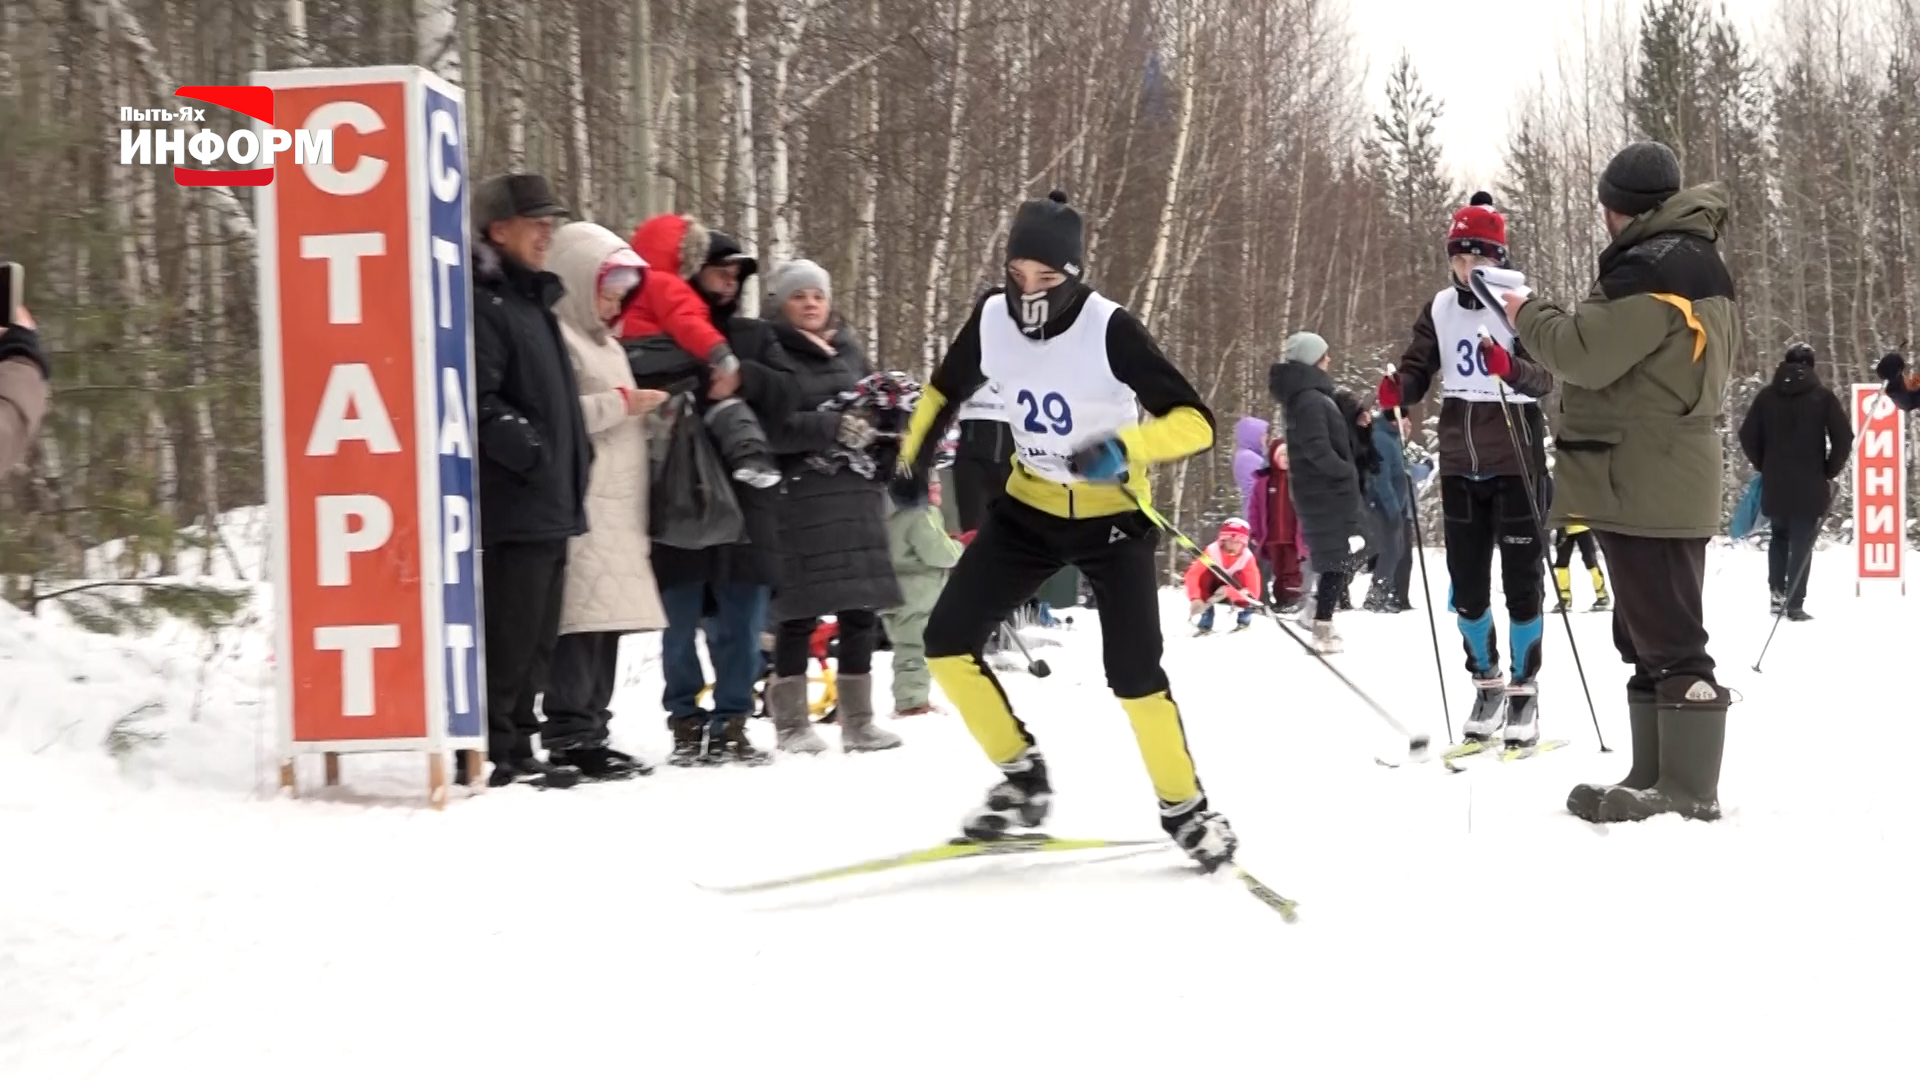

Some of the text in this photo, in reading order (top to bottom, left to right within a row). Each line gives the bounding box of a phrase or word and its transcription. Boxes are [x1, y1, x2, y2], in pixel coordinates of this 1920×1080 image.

[300, 101, 403, 716] СТАРТ
[429, 110, 474, 714] СТАРТ
[1017, 389, 1073, 436] 29
[1862, 393, 1895, 571] ФИНИШ
